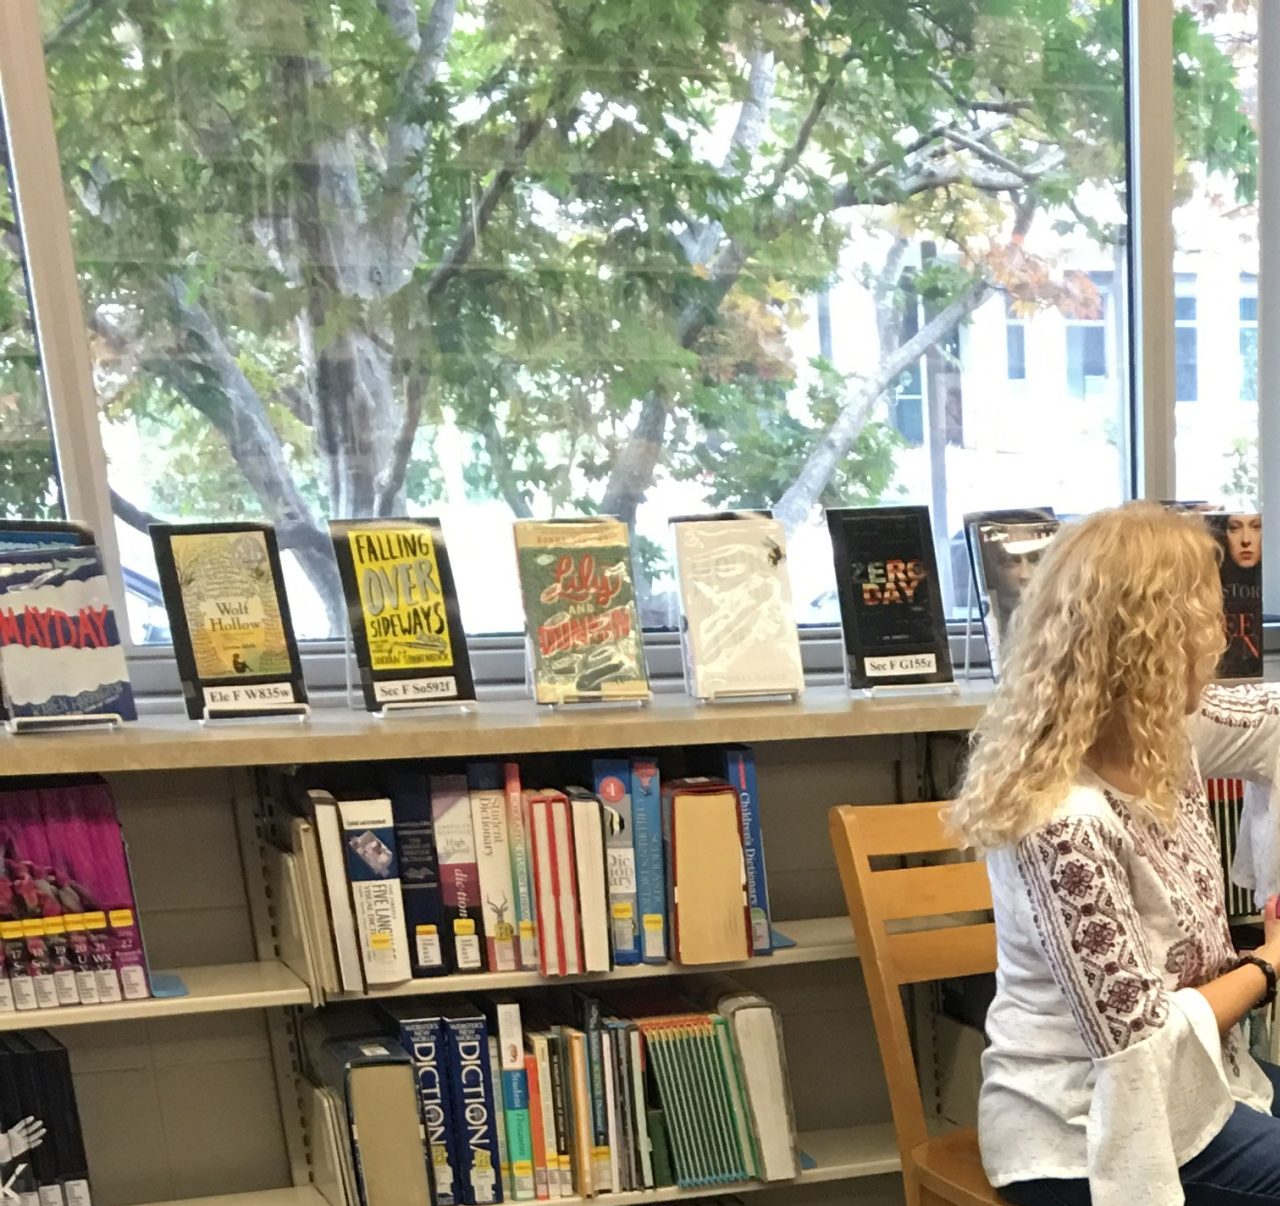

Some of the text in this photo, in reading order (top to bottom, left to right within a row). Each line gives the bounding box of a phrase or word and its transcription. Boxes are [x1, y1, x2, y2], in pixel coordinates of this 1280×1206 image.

[356, 533, 429, 564] FALLING
[540, 555, 622, 607] Lily
[852, 559, 928, 583] ZERO
[363, 559, 439, 616] OVER
[862, 580, 920, 605] DAY
[216, 601, 249, 616] Wolf
[370, 602, 444, 638] SIDEWAYS
[569, 605, 595, 615] AND
[0, 604, 108, 649] MAYDAY
[210, 618, 261, 632] Hollow
[870, 661, 888, 672] Sec
[890, 661, 898, 670] F
[210, 690, 232, 702] Ele
[233, 689, 242, 701] F
[380, 687, 398, 697] Sec
[402, 685, 410, 695] F
[479, 798, 494, 858] Dictionary
[491, 797, 504, 843] Student
[740, 792, 758, 905] Children's Dictionary
[372, 884, 388, 905] FIVE
[642, 870, 653, 912] DICTIO
[78, 954, 87, 963] U
[92, 953, 112, 962] WX
[121, 939, 132, 948] 22
[414, 1042, 447, 1145] DICTION
[458, 1041, 491, 1152] DICTION
[511, 1072, 522, 1108] Student
[514, 1112, 526, 1156] Thesaurus
